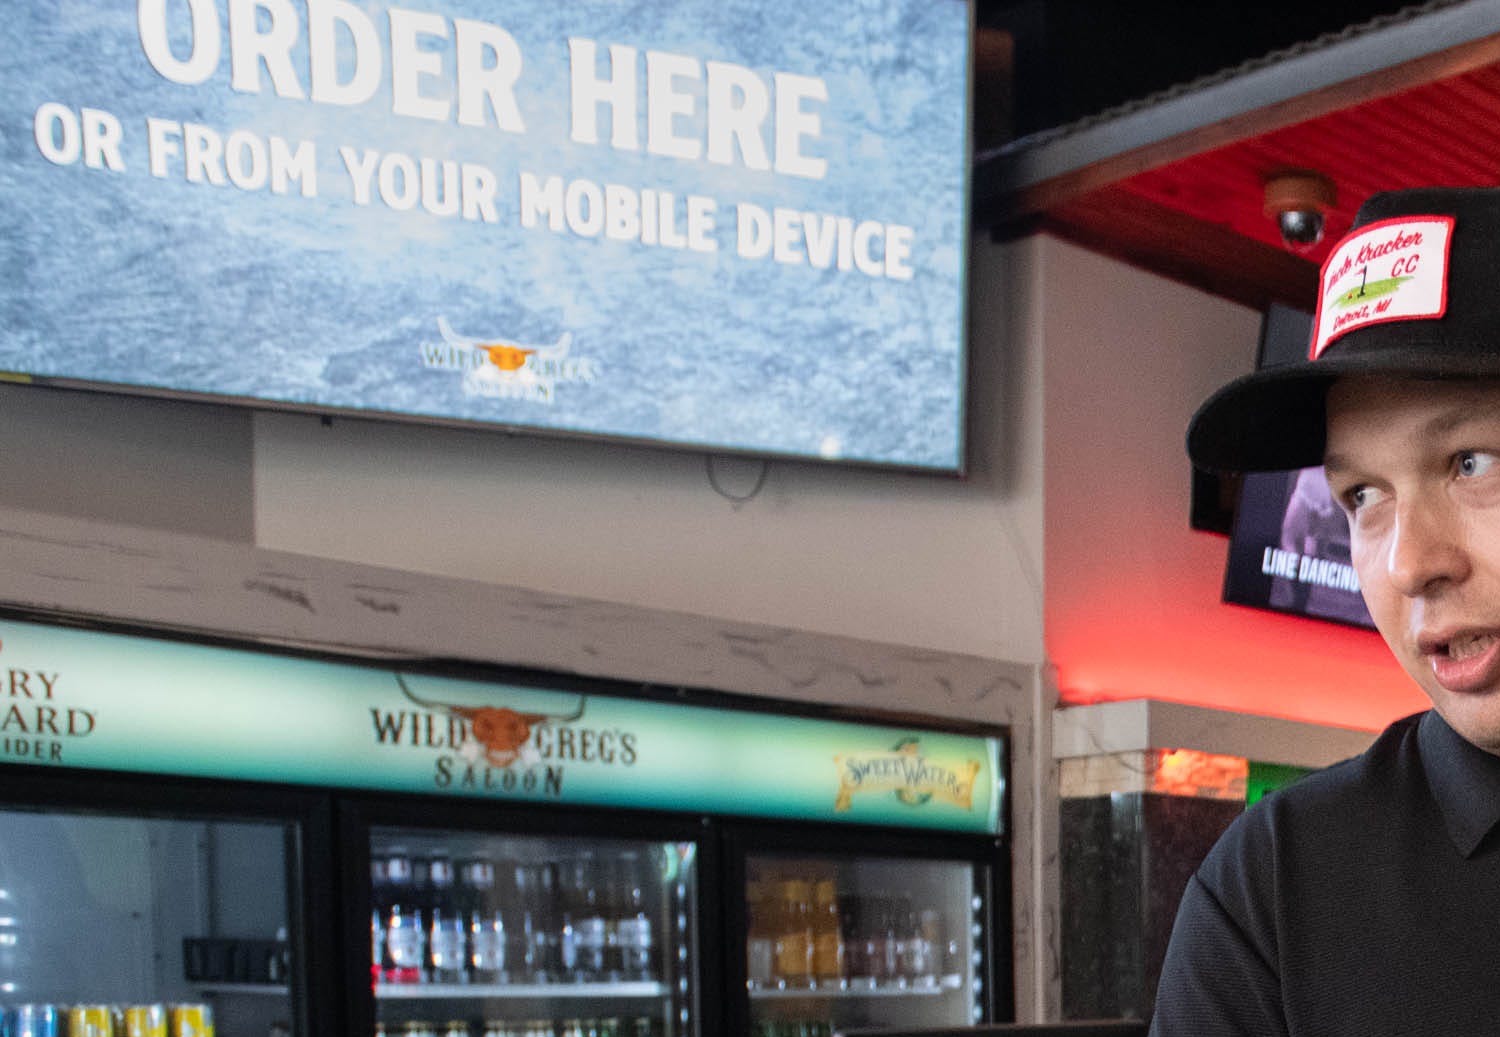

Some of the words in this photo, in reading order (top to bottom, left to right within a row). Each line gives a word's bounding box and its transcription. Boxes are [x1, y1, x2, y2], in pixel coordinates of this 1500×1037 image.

[138, 0, 527, 134] ORDER
[568, 37, 829, 180] HERE
[34, 102, 126, 173] OR
[146, 117, 317, 198] FROM
[339, 146, 499, 223] YOUR
[519, 172, 718, 253] MOBILE
[736, 202, 915, 280] DEVICE
[1355, 230, 1423, 267] Kracker
[1391, 254, 1420, 278] CC
[1262, 546, 1299, 581] LINE
[0, 668, 59, 700] RY
[370, 707, 468, 751] WILD
[535, 727, 638, 765] GREG'S
[434, 756, 563, 796] SALOON
